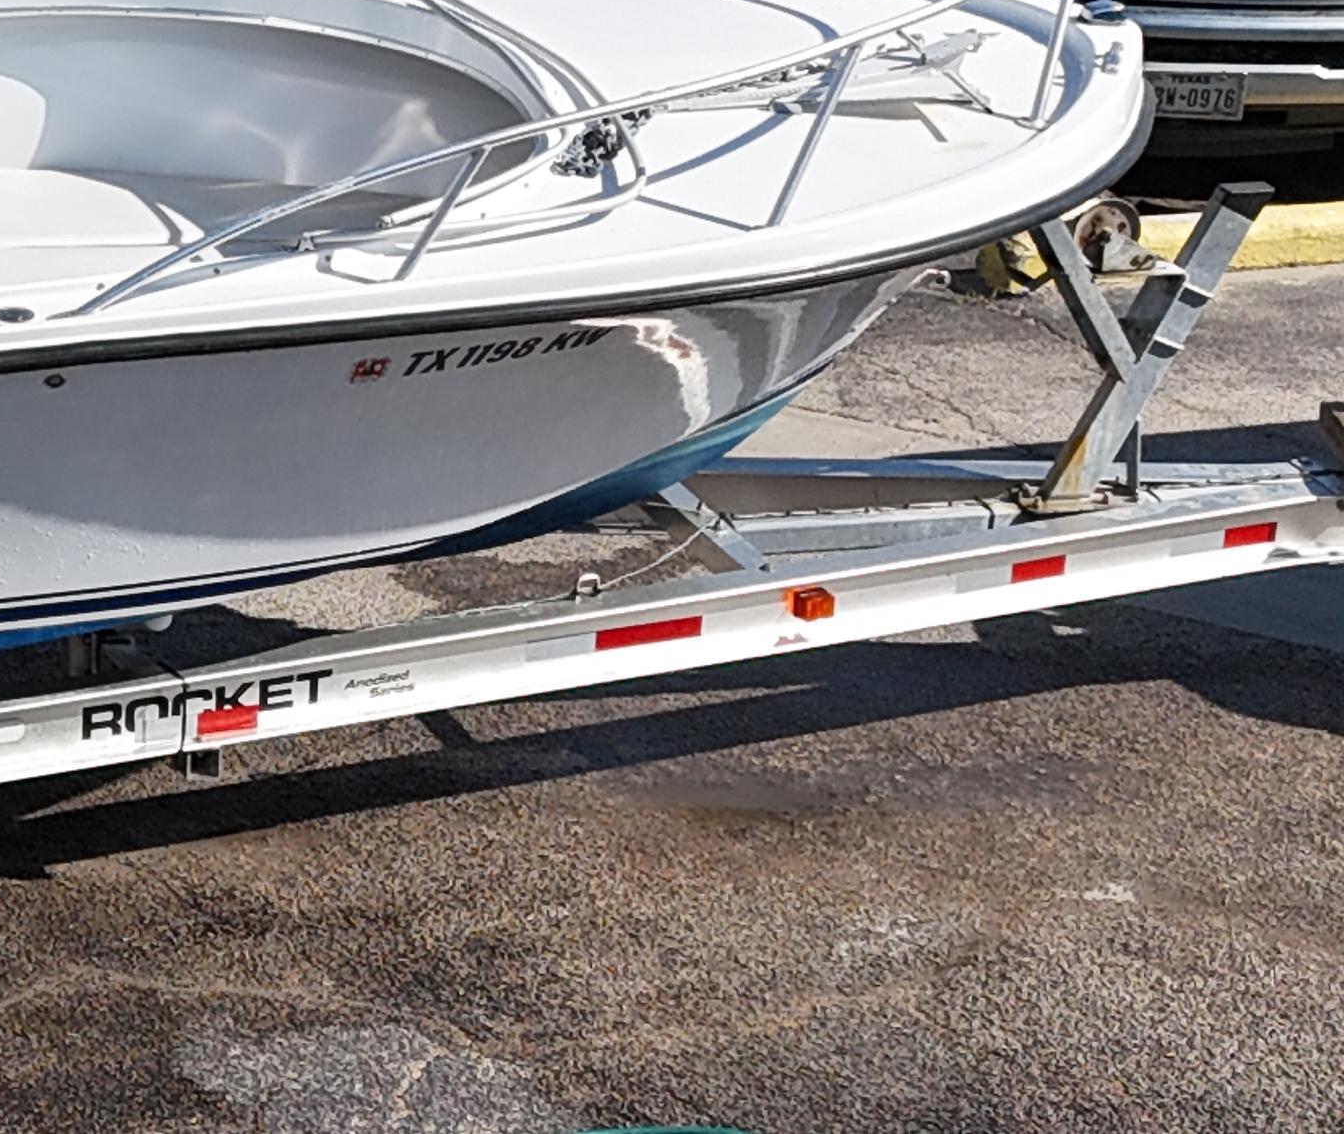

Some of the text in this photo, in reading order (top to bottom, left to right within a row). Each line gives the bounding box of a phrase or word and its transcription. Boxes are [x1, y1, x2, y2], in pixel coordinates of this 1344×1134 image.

[1171, 74, 1212, 84] TEXAS
[403, 346, 460, 377] TX
[456, 336, 543, 368] 1198
[540, 326, 613, 355] KW
